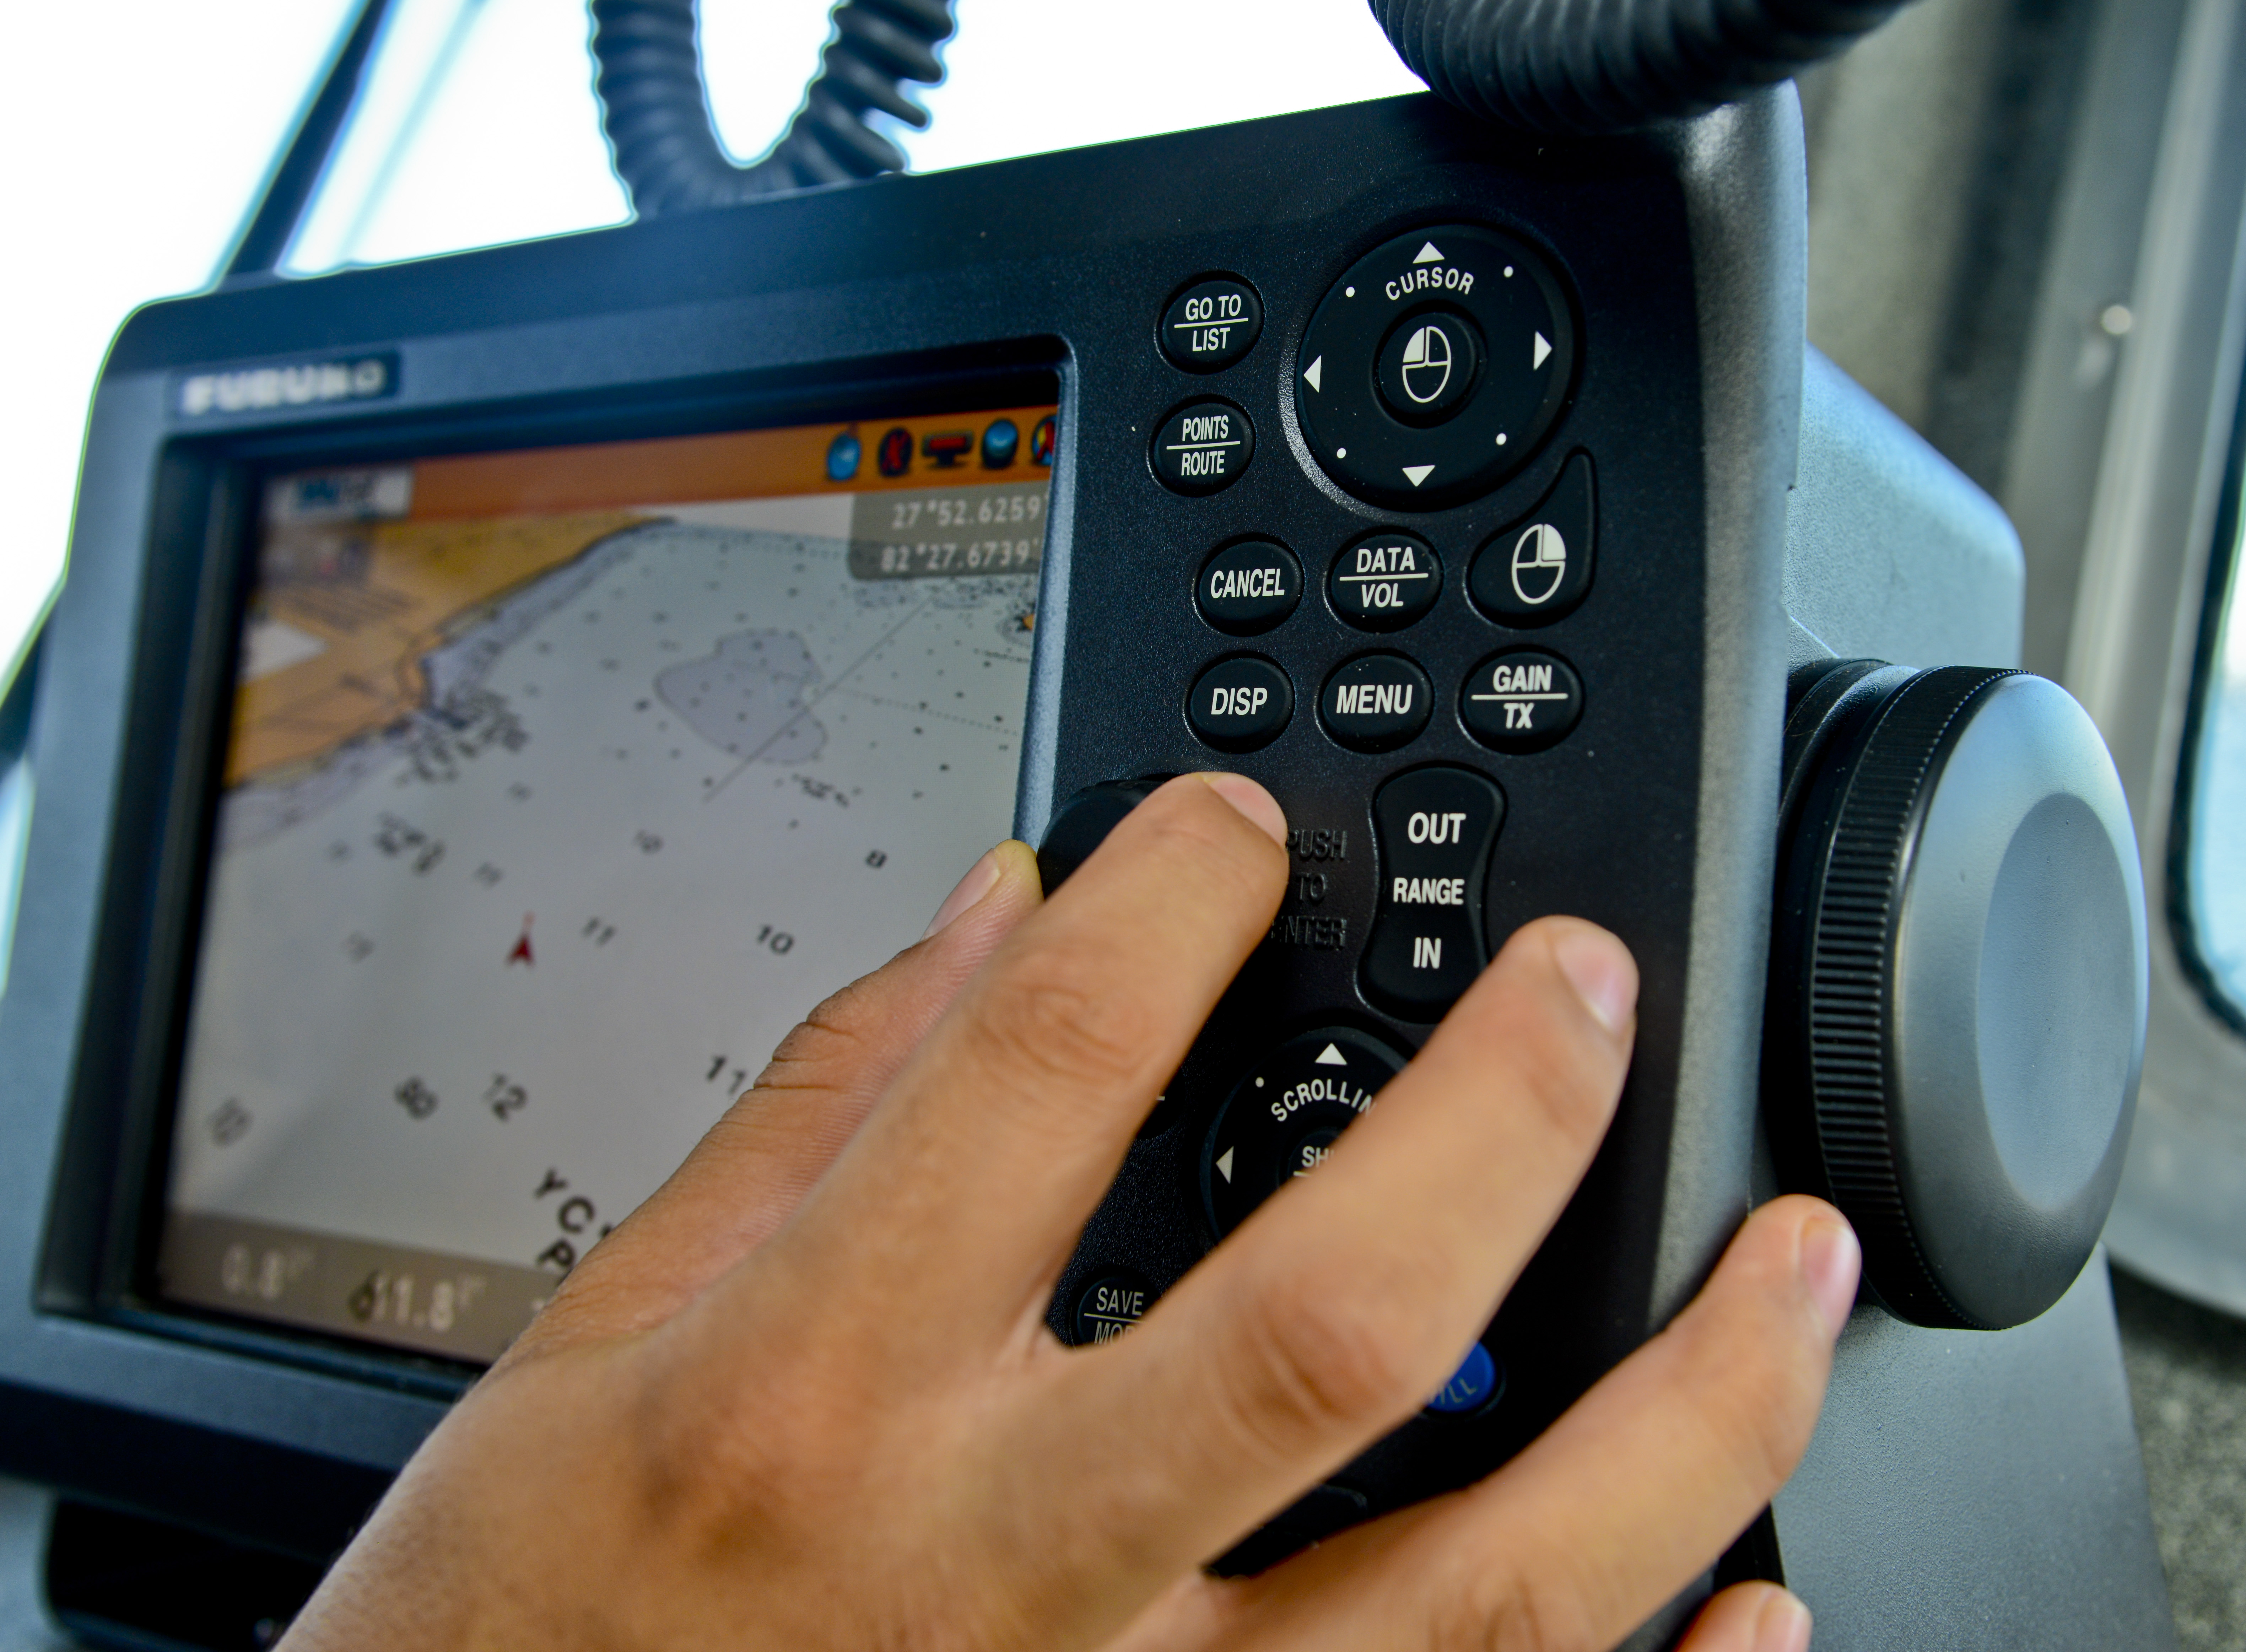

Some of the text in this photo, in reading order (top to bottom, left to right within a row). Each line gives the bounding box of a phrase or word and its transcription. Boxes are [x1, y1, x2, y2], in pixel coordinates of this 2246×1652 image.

[1385, 266, 1474, 301] CURSOR
[1185, 294, 1242, 321] GO TO
[1191, 327, 1231, 352] LIST
[1182, 415, 1229, 442] POINTS
[1181, 450, 1226, 476] ROUTE
[1356, 546, 1416, 573] DATA
[1210, 568, 1285, 599] CANCEL
[1361, 582, 1404, 608] VOL
[1492, 664, 1553, 693] GAIN
[1210, 687, 1268, 716] DISP
[1336, 684, 1413, 714] MENU
[1503, 702, 1535, 729] TX
[1408, 812, 1467, 844] OUT
[1295, 872, 1326, 903] TO
[1393, 877, 1465, 905] RANGE
[757, 924, 794, 955] 10
[1413, 936, 1442, 969] IN
[1301, 1145, 1334, 1168] SH
[1096, 1286, 1144, 1316] SAVE
